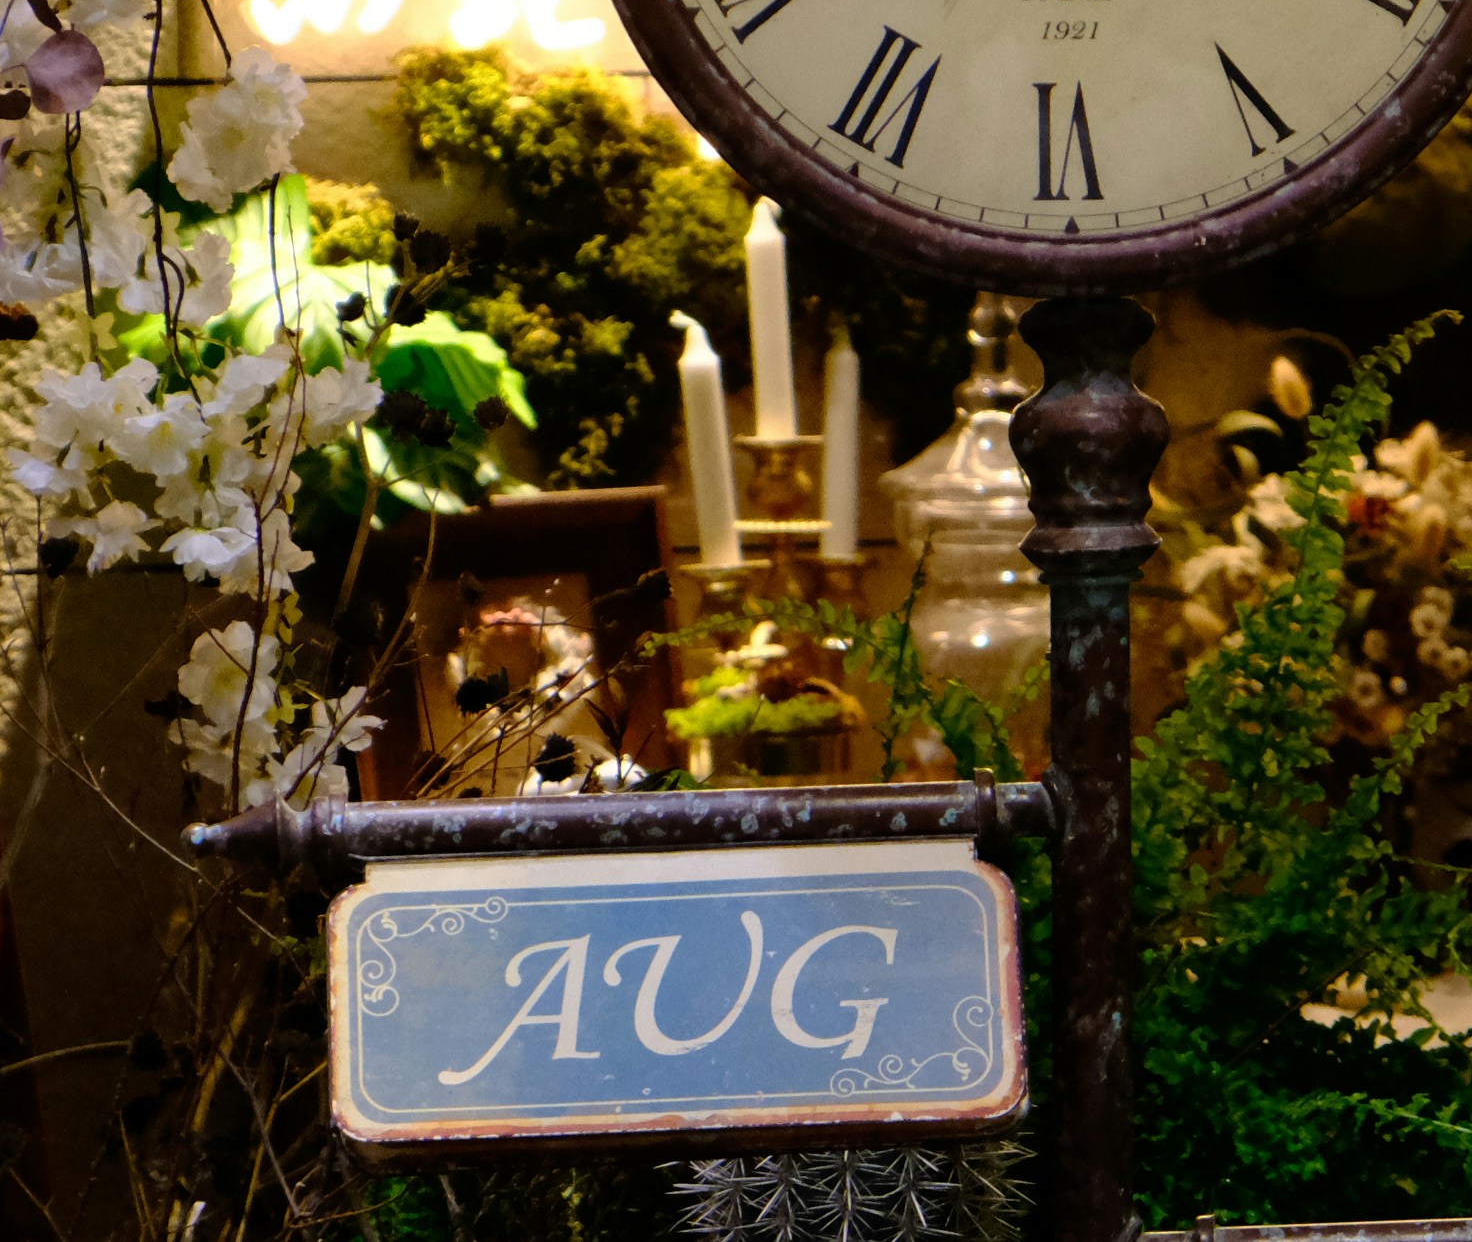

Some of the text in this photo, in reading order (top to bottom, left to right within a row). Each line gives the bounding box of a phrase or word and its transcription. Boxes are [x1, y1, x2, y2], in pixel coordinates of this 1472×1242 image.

[1042, 21, 1099, 40] 1921
[827, 24, 943, 169] VII
[1032, 81, 1105, 201] VI
[1214, 41, 1297, 157] V
[437, 911, 899, 1085] AUG
